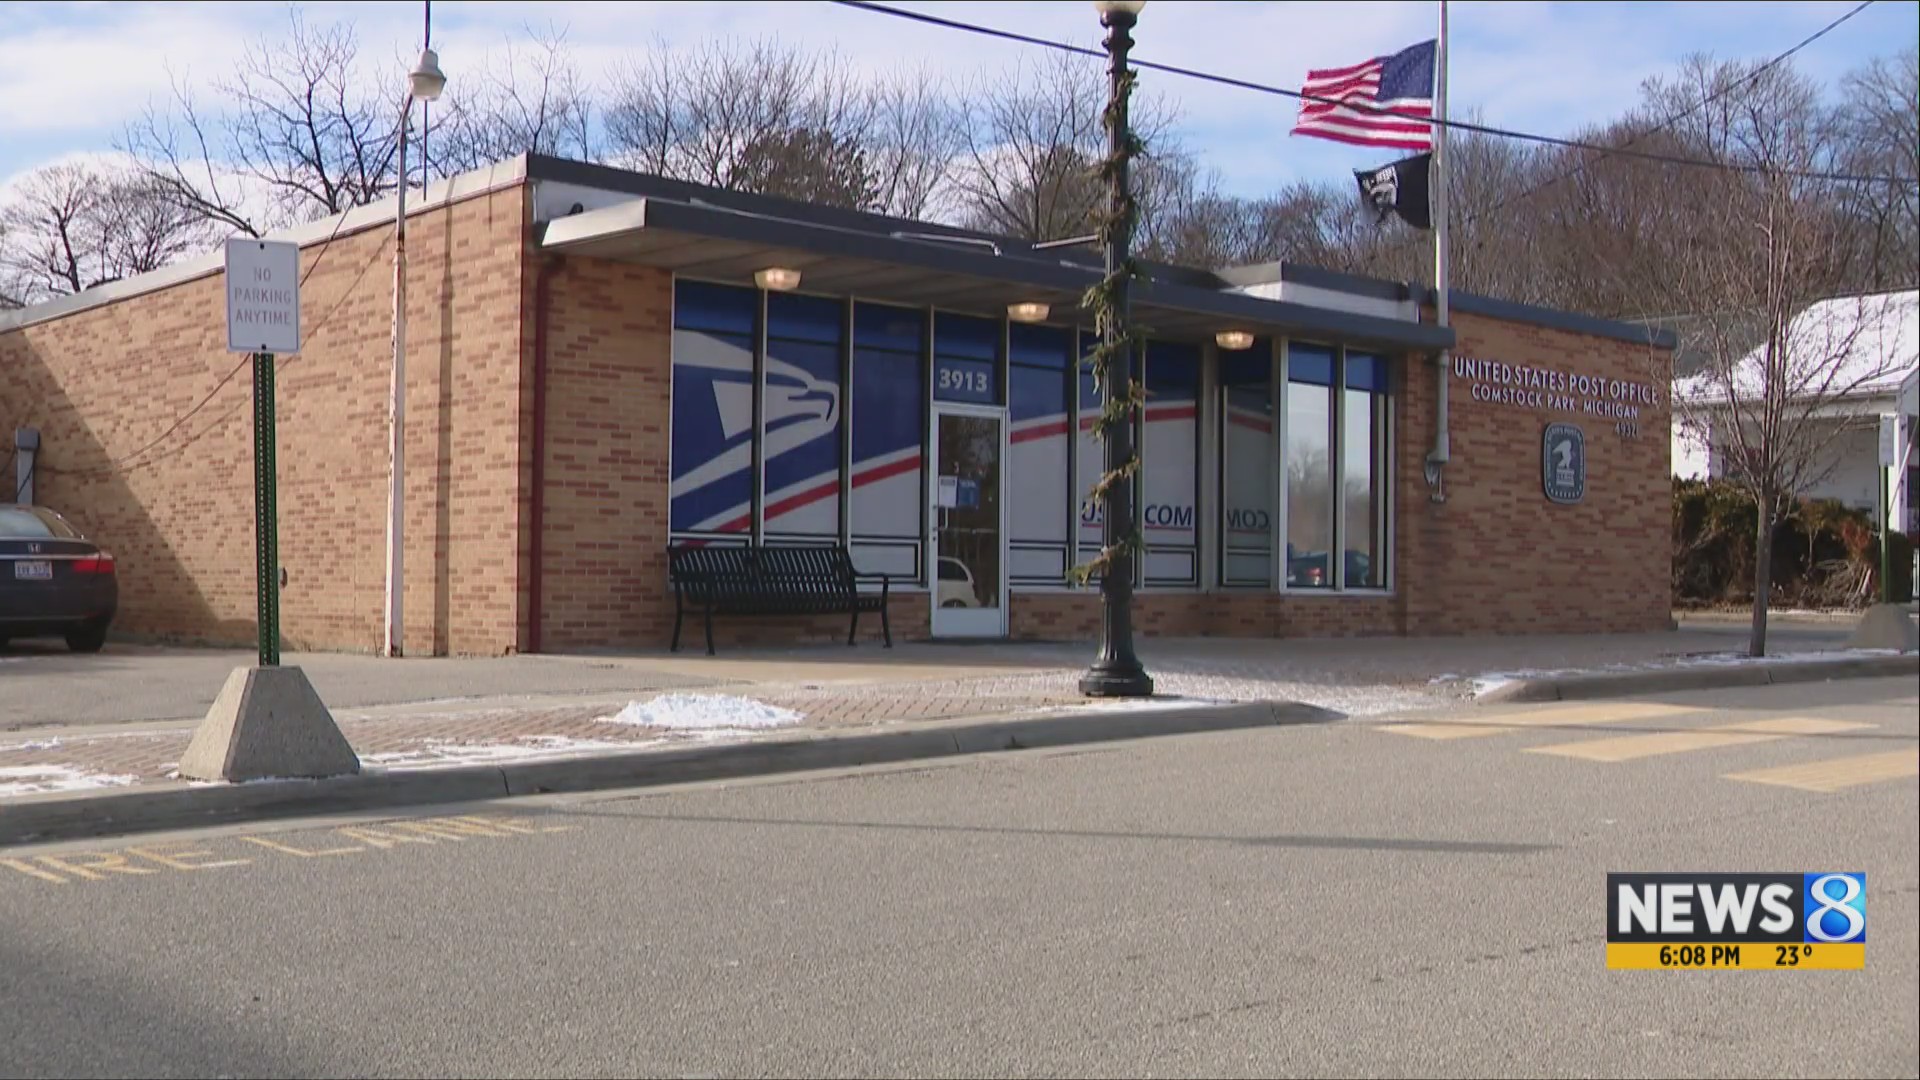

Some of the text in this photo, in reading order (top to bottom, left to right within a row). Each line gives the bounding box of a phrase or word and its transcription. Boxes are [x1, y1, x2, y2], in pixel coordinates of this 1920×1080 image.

[253, 266, 272, 282] NO
[234, 286, 292, 305] PARKING
[235, 308, 292, 325] ANYTIME
[938, 367, 988, 392] 3913
[1453, 356, 1659, 405] UNITED STATES POST OFFICE
[1471, 383, 1543, 408] COMSTOCK
[1583, 399, 1638, 420] MICHIGAN
